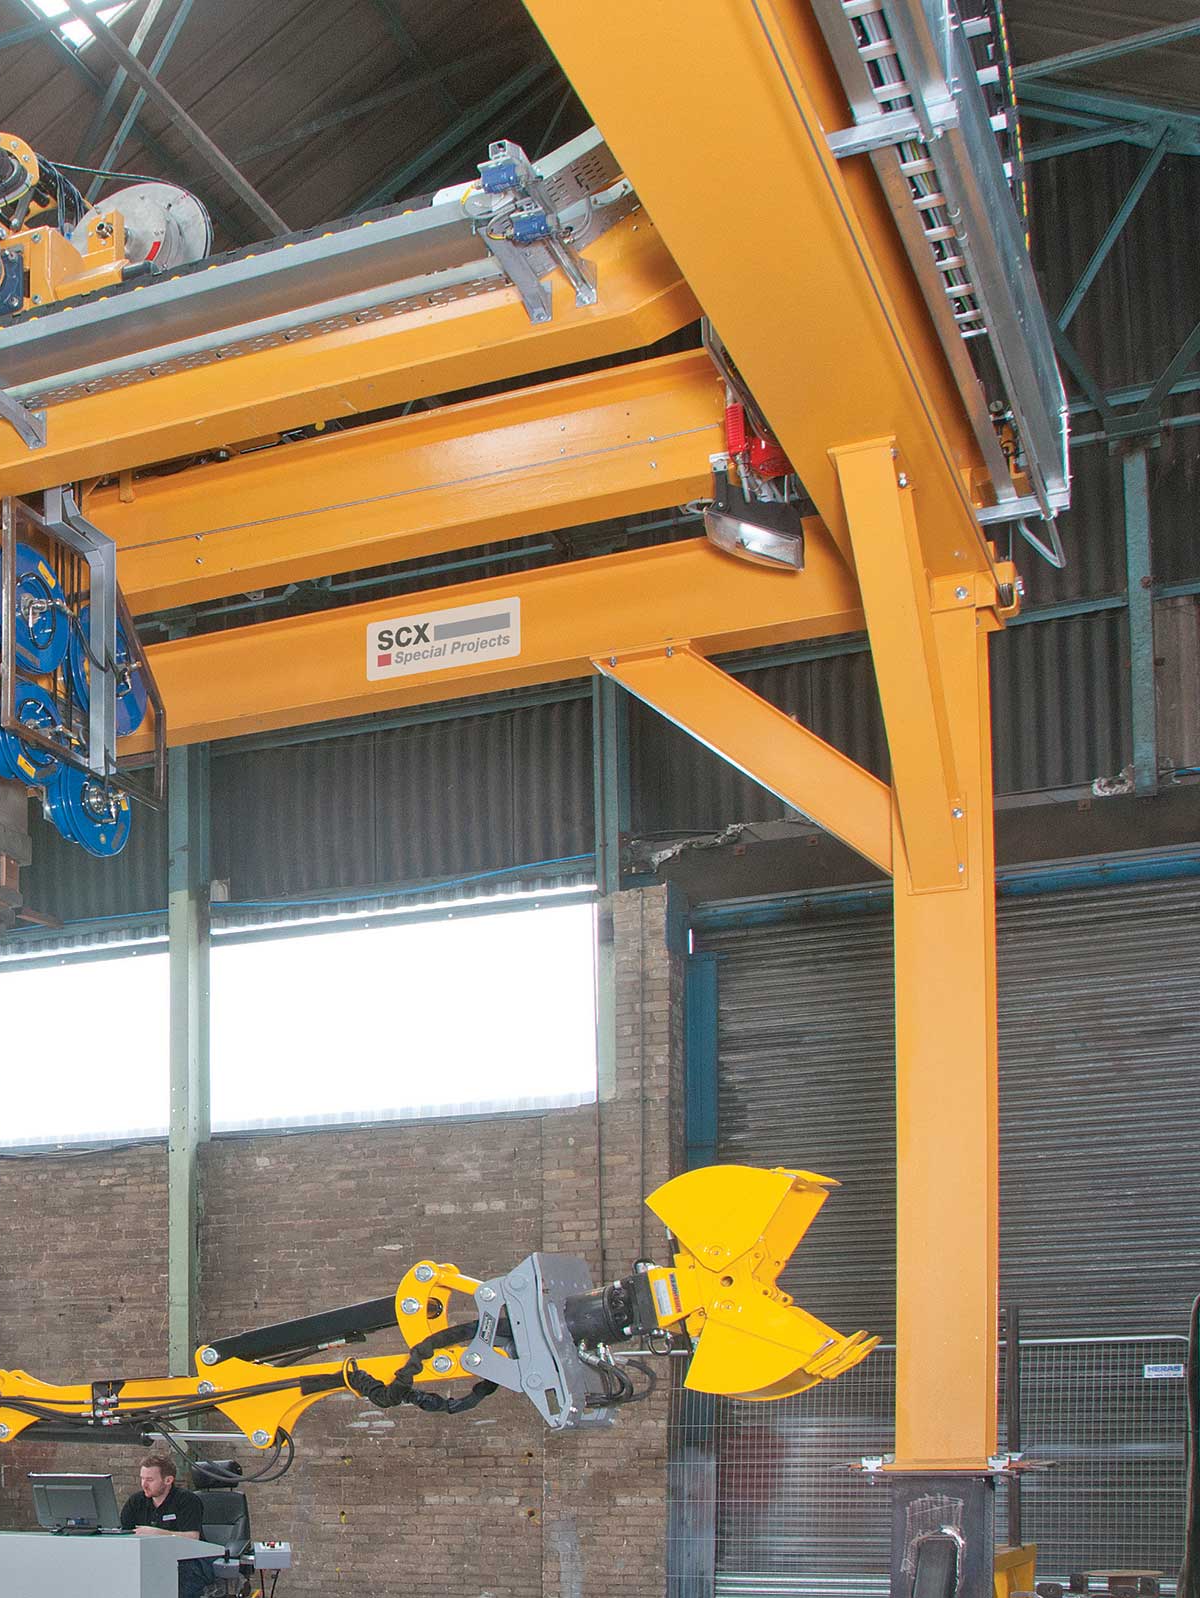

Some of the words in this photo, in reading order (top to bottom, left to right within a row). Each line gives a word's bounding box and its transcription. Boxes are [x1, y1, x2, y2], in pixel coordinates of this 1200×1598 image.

[377, 622, 430, 651] SCX
[394, 643, 447, 665] Special
[450, 634, 510, 655] Projects
